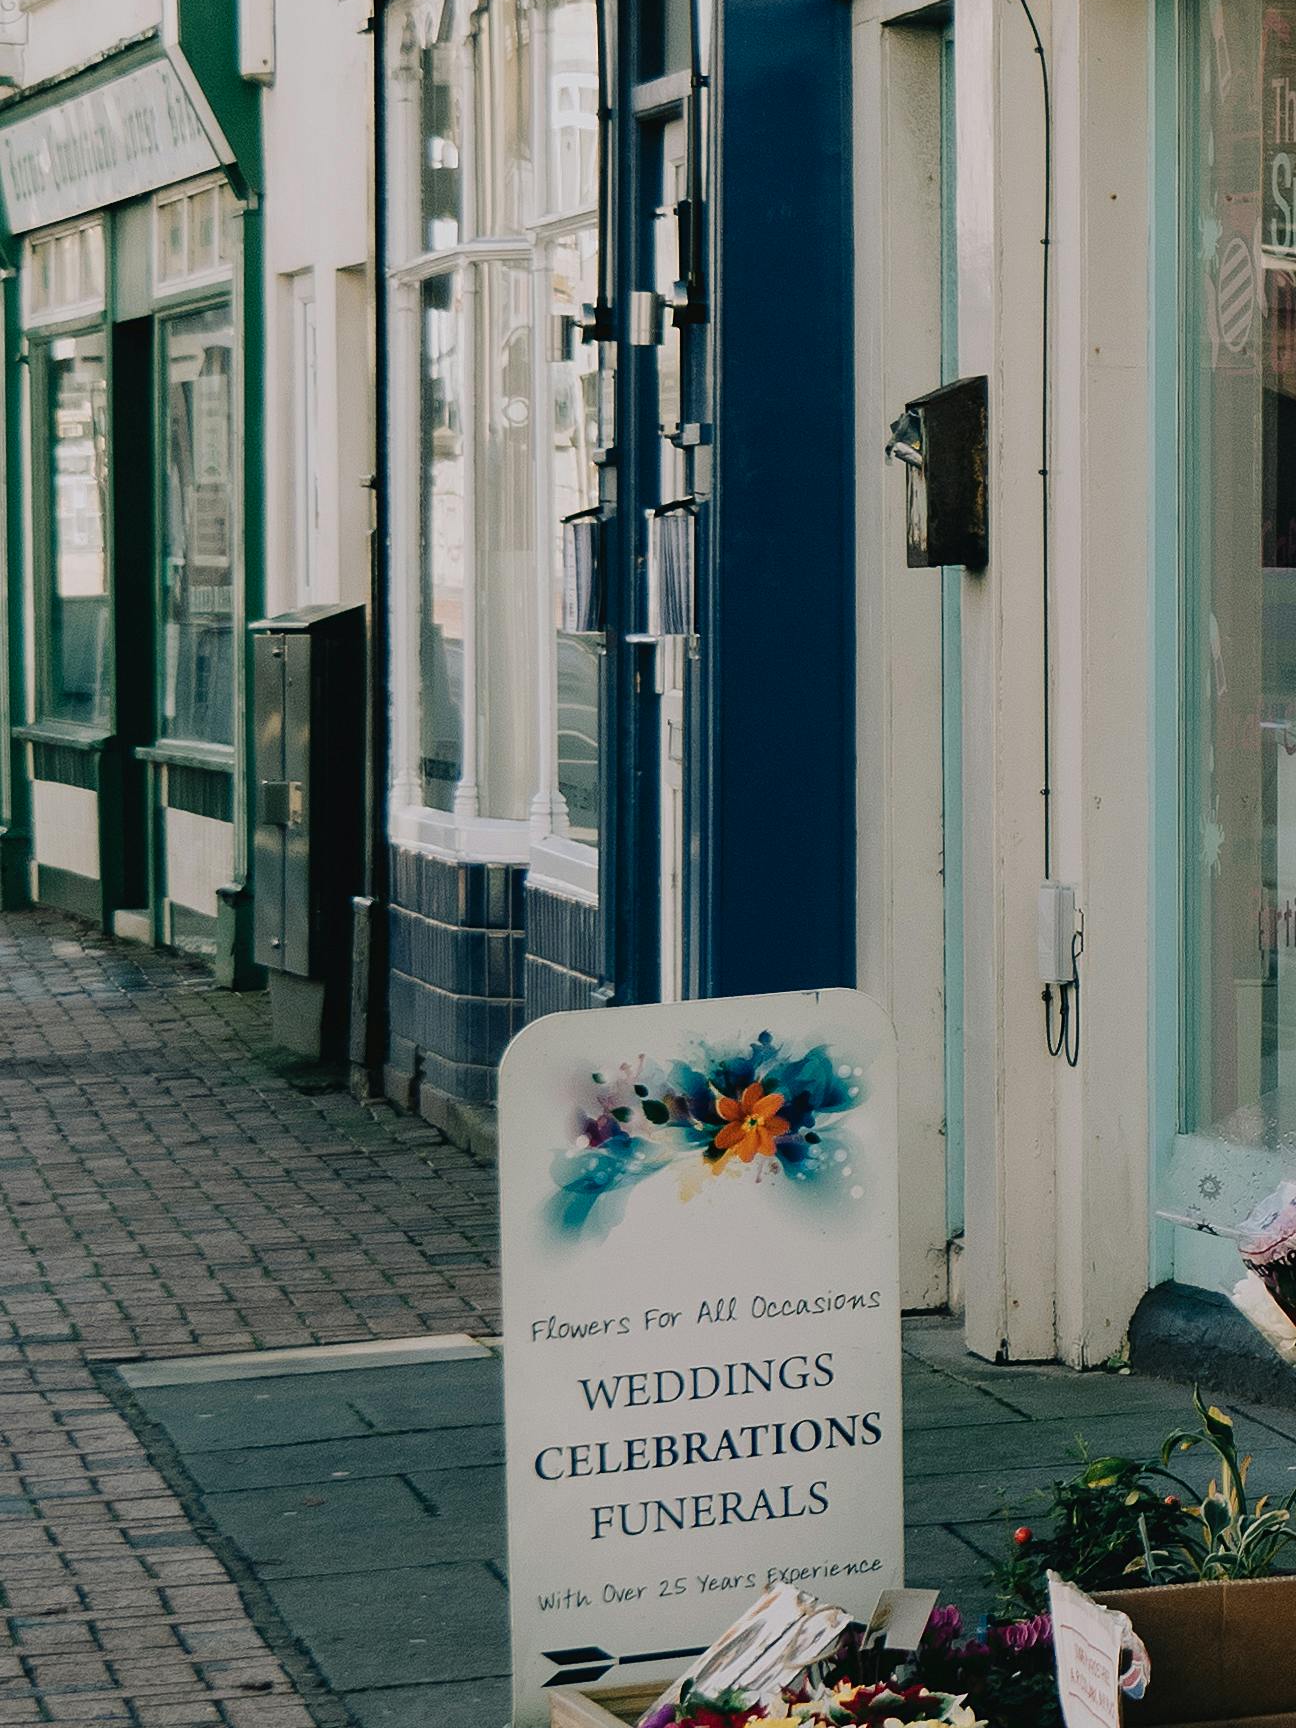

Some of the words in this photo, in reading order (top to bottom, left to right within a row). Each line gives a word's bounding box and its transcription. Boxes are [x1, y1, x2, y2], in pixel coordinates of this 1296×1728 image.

[531, 1310, 630, 1343] Flowers
[644, 1307, 682, 1333] For
[696, 1297, 738, 1323] All
[751, 1287, 882, 1319] Occasions
[577, 1351, 835, 1413] WEDDINGS
[534, 1411, 883, 1482] CELEBRATIONS
[590, 1479, 831, 1541] FUNERALS
[538, 1588, 592, 1614] With
[602, 1581, 647, 1604] Over
[658, 1578, 687, 1597] 25
[697, 1571, 756, 1595] Years
[766, 1555, 884, 1587] Experience
